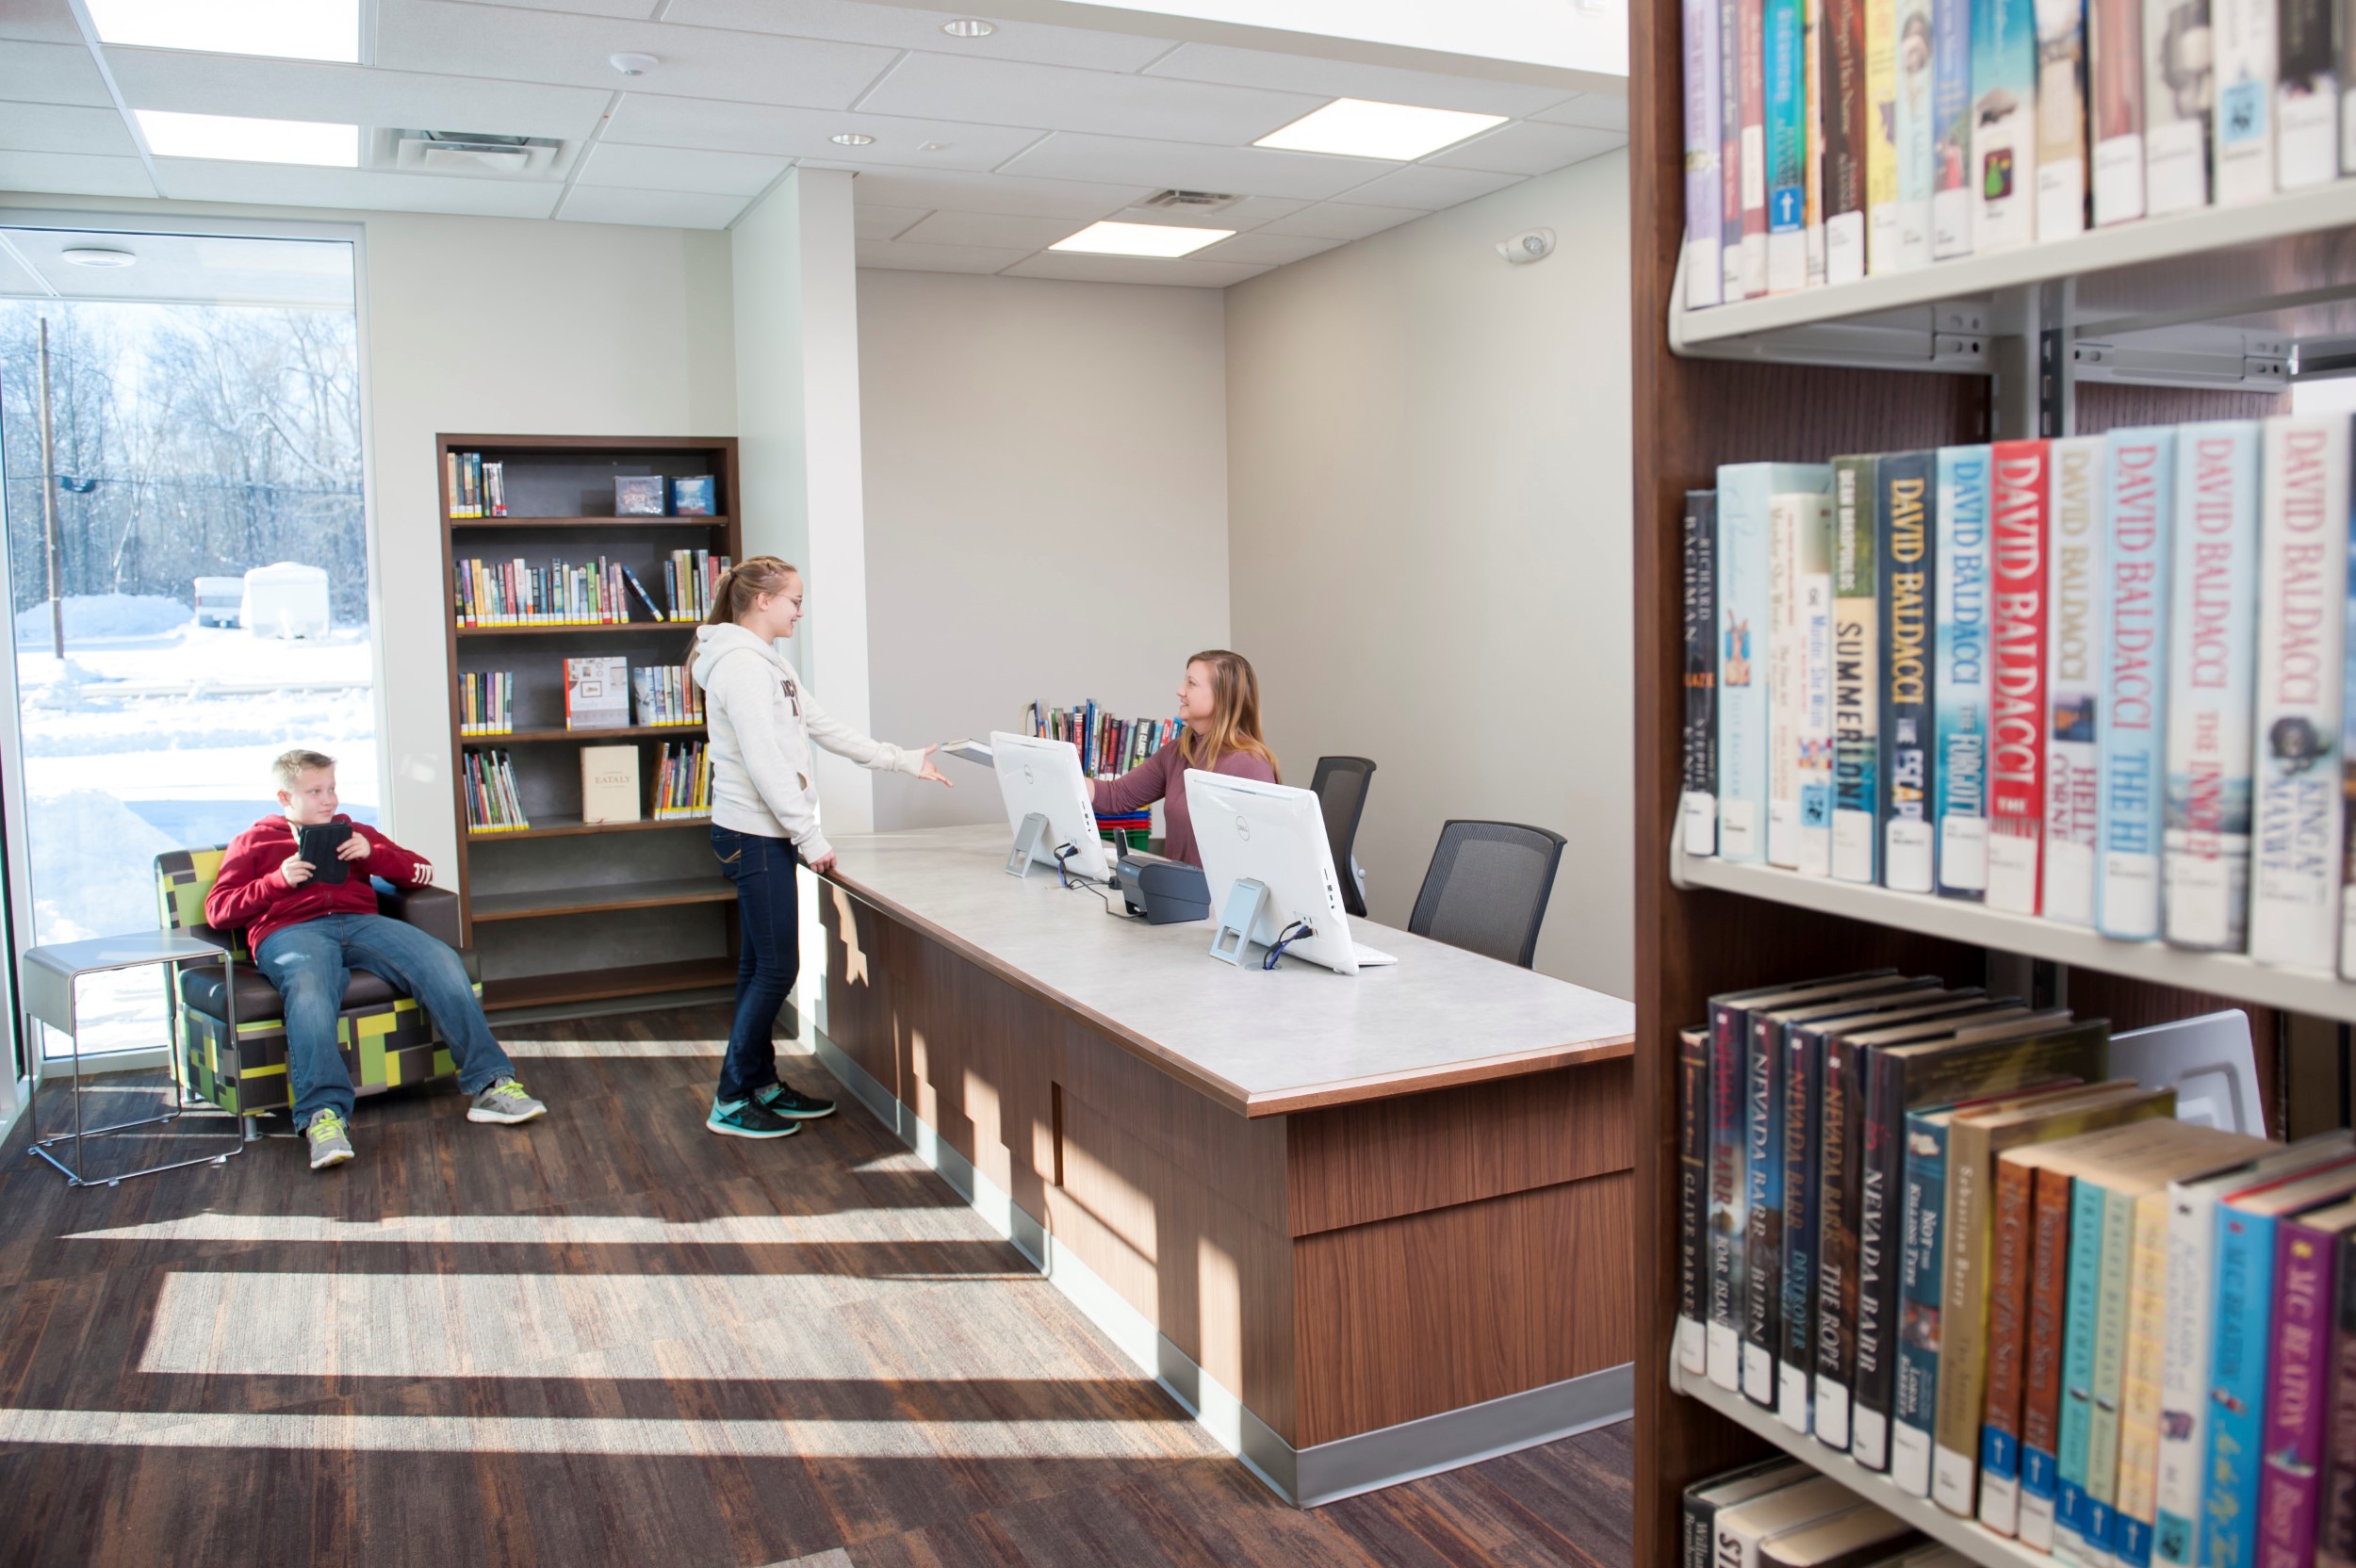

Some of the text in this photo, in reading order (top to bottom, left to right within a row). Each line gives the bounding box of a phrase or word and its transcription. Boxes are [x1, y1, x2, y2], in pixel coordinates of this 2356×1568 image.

[1837, 469, 1855, 506] DEAN
[1684, 516, 1697, 643] BACHMAN
[1890, 478, 1924, 705] DAVID BALDACCI
[1951, 462, 1982, 686] DAVID BALDACCI
[2058, 449, 2090, 682] DAVID BALDACCI
[2111, 445, 2157, 730] DAVID BALDACCI
[2190, 438, 2233, 689] DAVID BALDACCI
[2278, 430, 2327, 706] DAVID BALDACCI
[1993, 455, 2040, 785] DAVID BALDACCI
[1137, 735, 1148, 757] CLANCY
[1896, 718, 1917, 744] THE
[1958, 703, 1977, 730] THE
[2195, 711, 2219, 753] THE
[1946, 733, 1982, 818] FORGOTT
[2111, 751, 2151, 816] THE
[2109, 820, 2150, 853] HI
[1712, 1142, 1734, 1206] BARR
[1750, 1052, 1769, 1238] NEVADA BARR
[1785, 1069, 1807, 1230] NEVADA BARR
[1823, 1085, 1843, 1245] NEVADA BARR
[1684, 1171, 1696, 1237] CLIVE
[1715, 1235, 1729, 1273] BOAR
[1953, 1165, 1974, 1308] Sebastian Barry
[1750, 1266, 1766, 1342] BURN
[1792, 1250, 1808, 1349] DESTROYER
[1819, 1262, 1841, 1372] THE ROPE
[1858, 1166, 1884, 1373] NEVADA BARR
[2275, 1322, 2314, 1435] BEATON
[1697, 1521, 1708, 1568] Willia
[1719, 1532, 1743, 1568] ST
